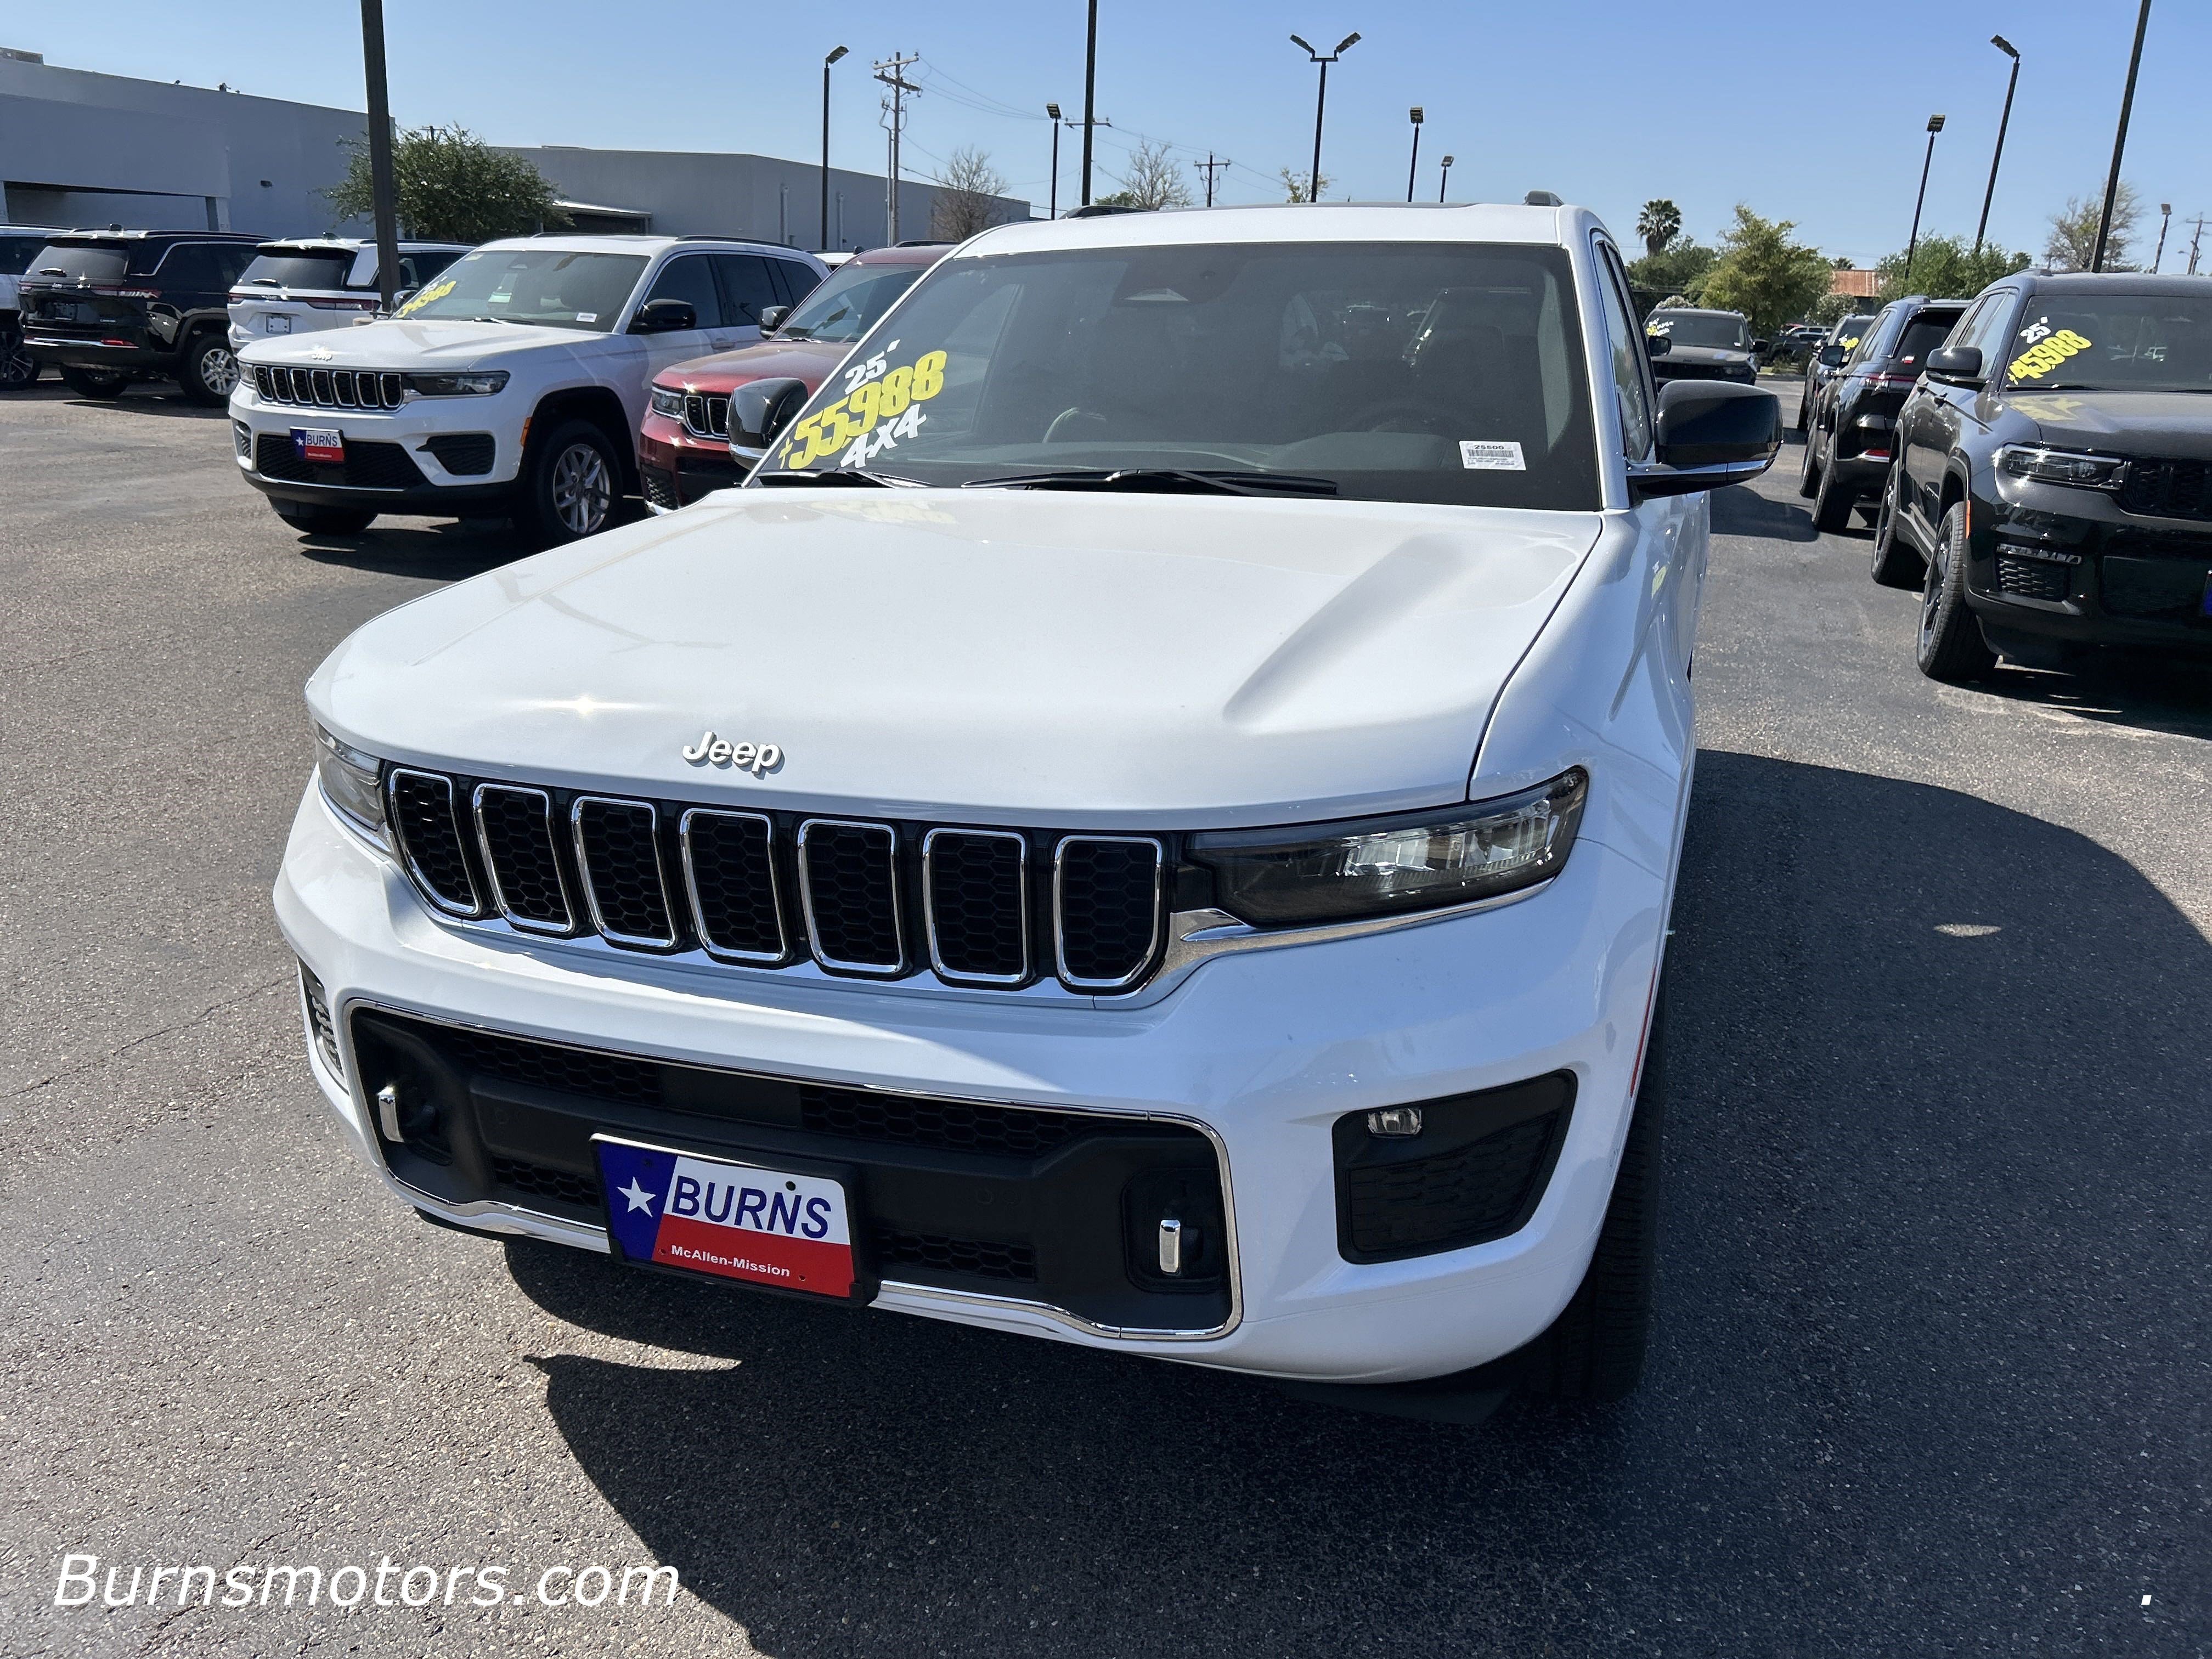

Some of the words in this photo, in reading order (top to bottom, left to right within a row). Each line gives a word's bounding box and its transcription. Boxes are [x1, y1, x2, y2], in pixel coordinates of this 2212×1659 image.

[307, 435, 337, 447] BURNS
[682, 731, 782, 775] Jeep
[671, 1175, 832, 1239] BURNS
[671, 1244, 791, 1278] McAllen-Mission
